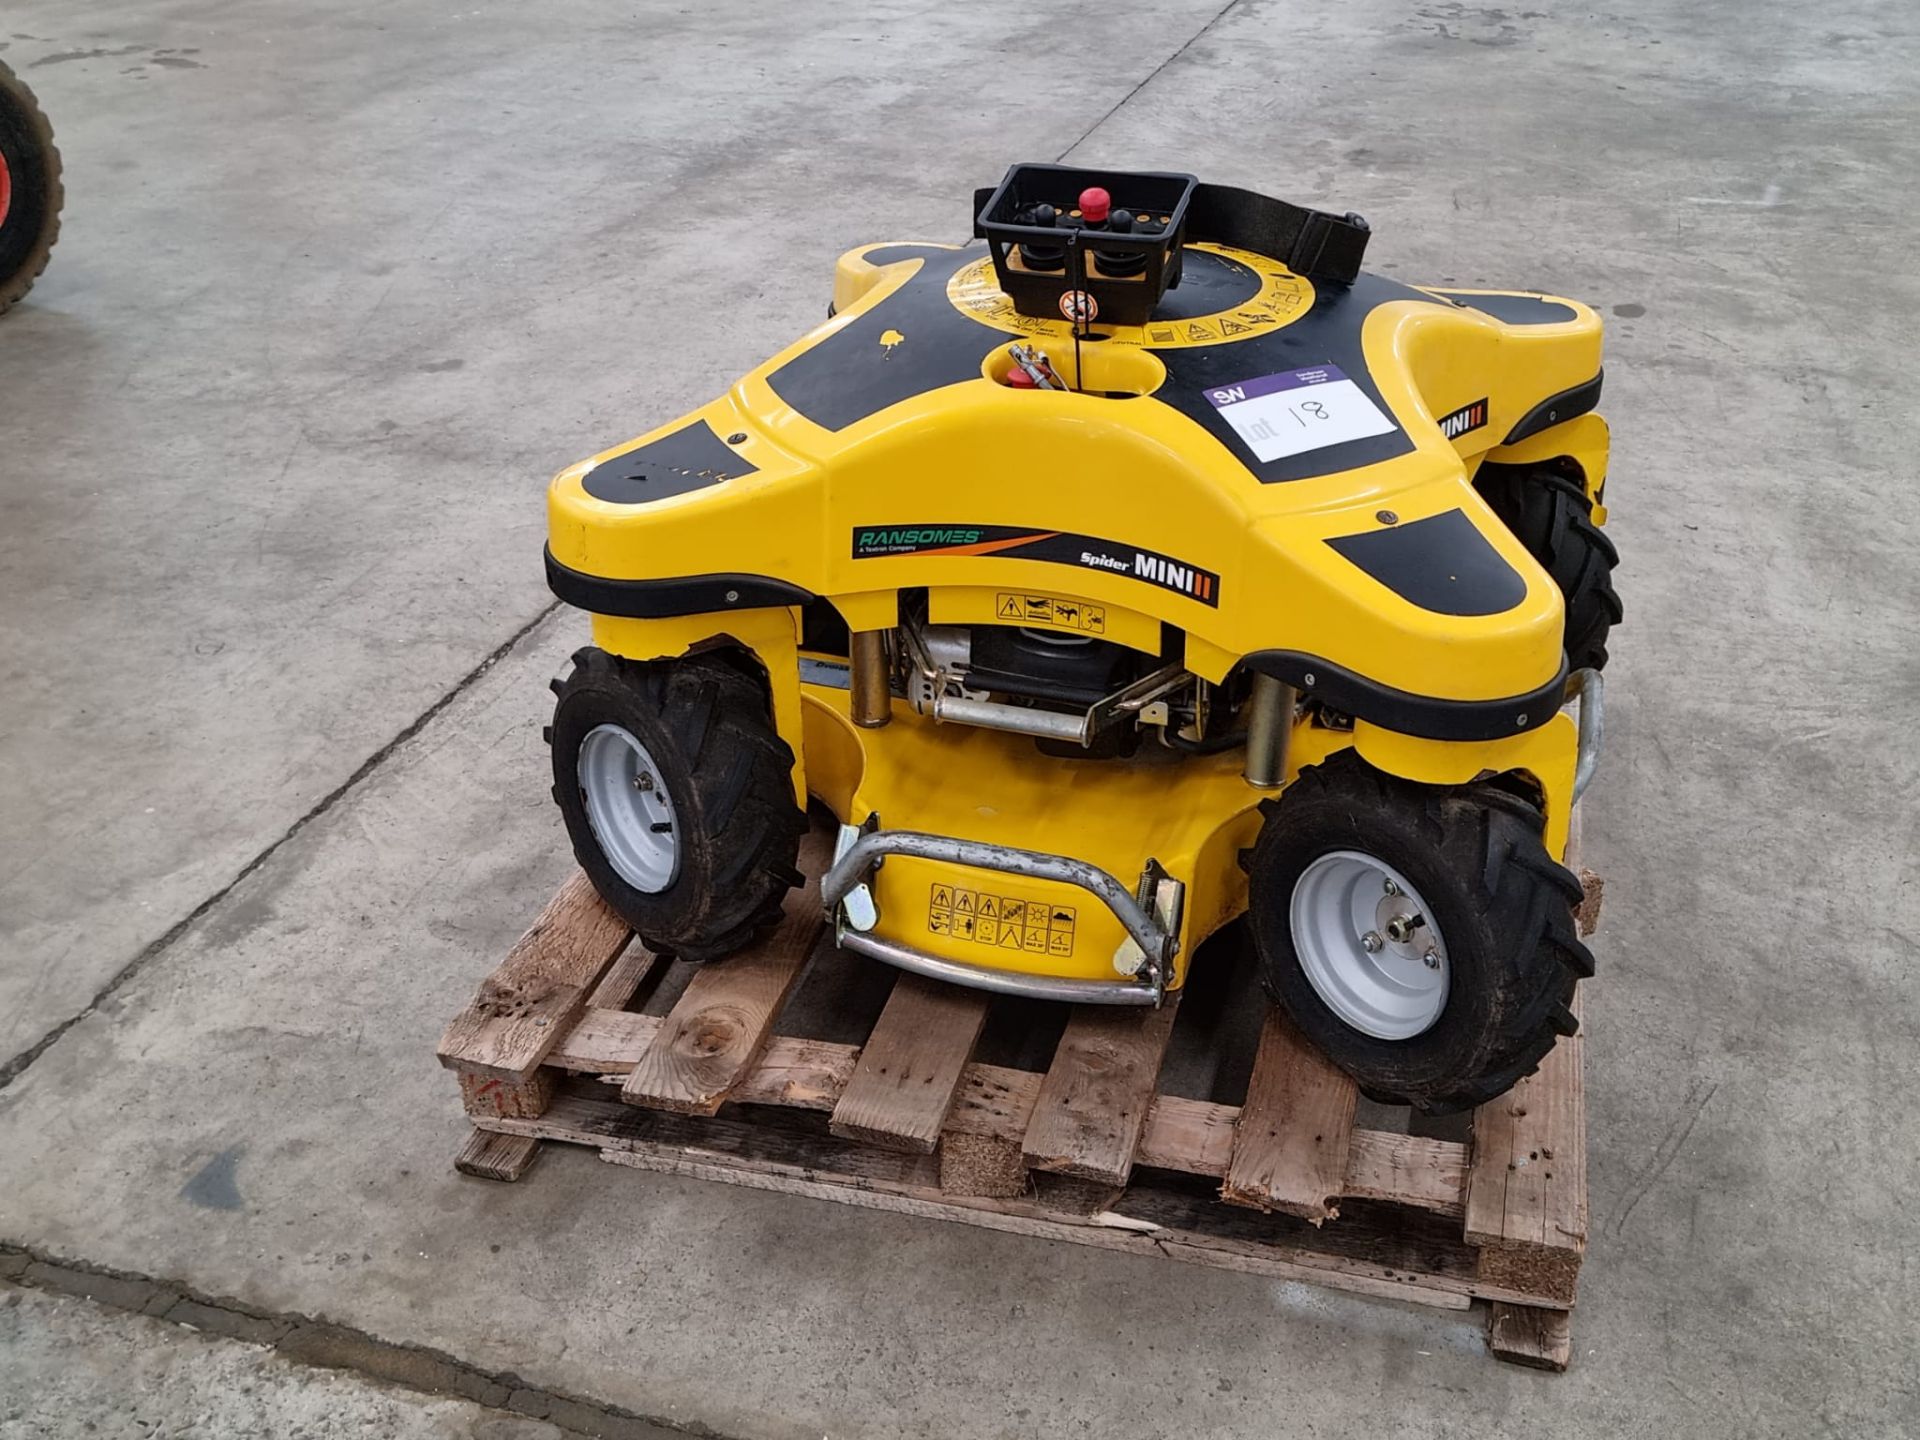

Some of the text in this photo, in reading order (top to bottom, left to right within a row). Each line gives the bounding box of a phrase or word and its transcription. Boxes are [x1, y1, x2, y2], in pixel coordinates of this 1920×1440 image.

[1288, 401, 1330, 428] 18
[858, 530, 980, 546] RANSOMES
[1080, 551, 1131, 572] Spider
